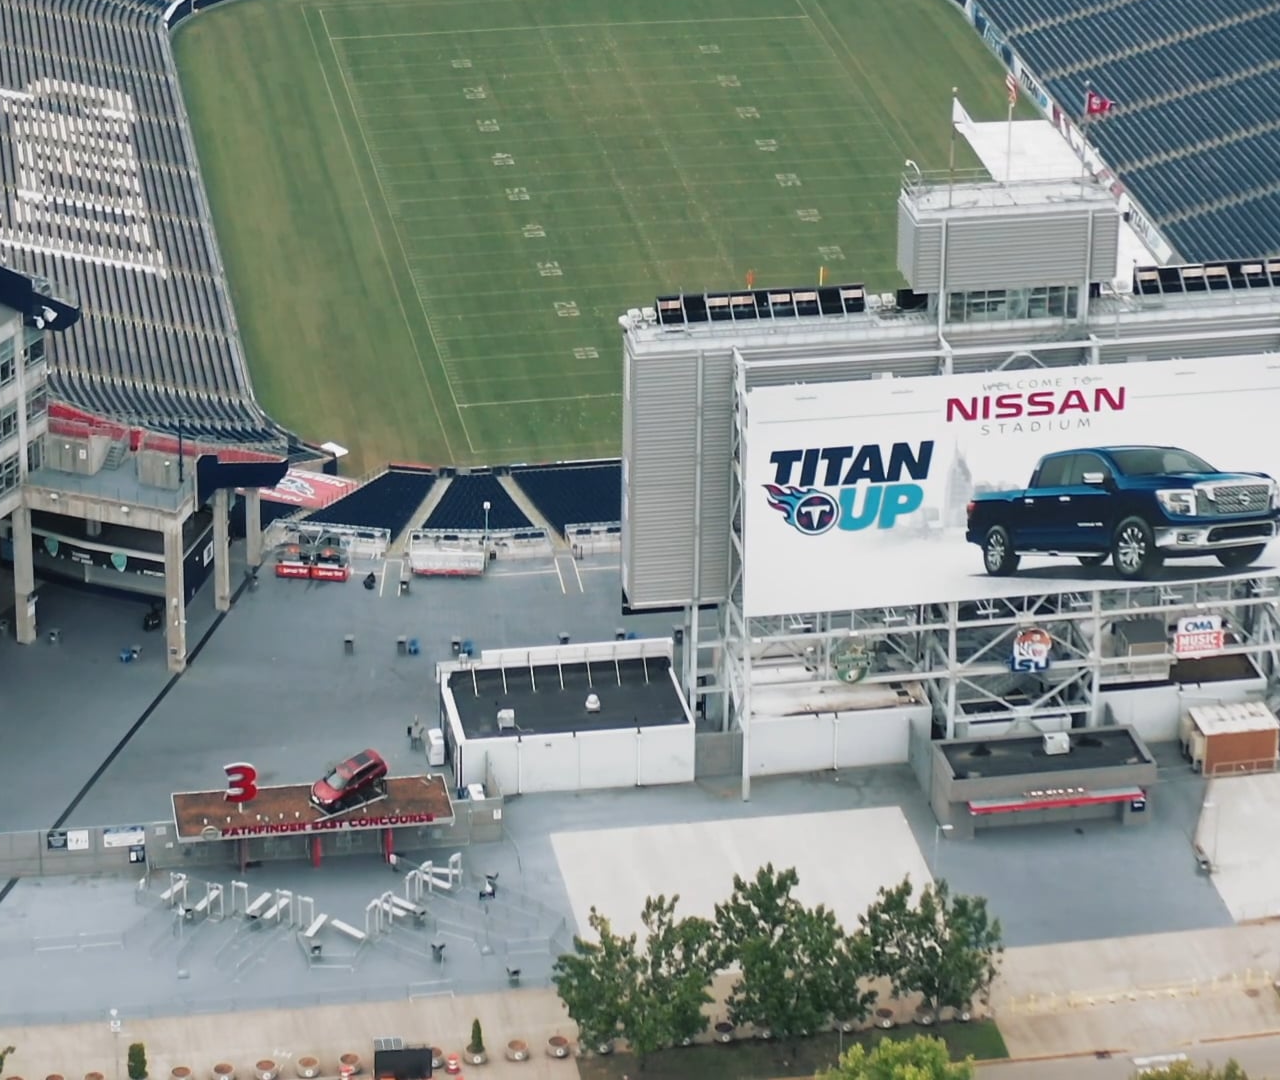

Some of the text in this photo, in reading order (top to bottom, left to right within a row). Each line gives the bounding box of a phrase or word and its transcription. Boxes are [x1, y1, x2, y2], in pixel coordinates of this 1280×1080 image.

[982, 377, 1063, 392] WELCOME
[946, 387, 1125, 421] NISSAN
[980, 418, 1091, 436] STADIUM
[770, 440, 934, 487] TITAN
[839, 483, 926, 532] UP
[1184, 620, 1213, 633] CMA
[1179, 631, 1218, 647] MUSIC
[223, 761, 258, 803] 3
[221, 813, 435, 837] PATHFINDER EAST CONCOURSE
